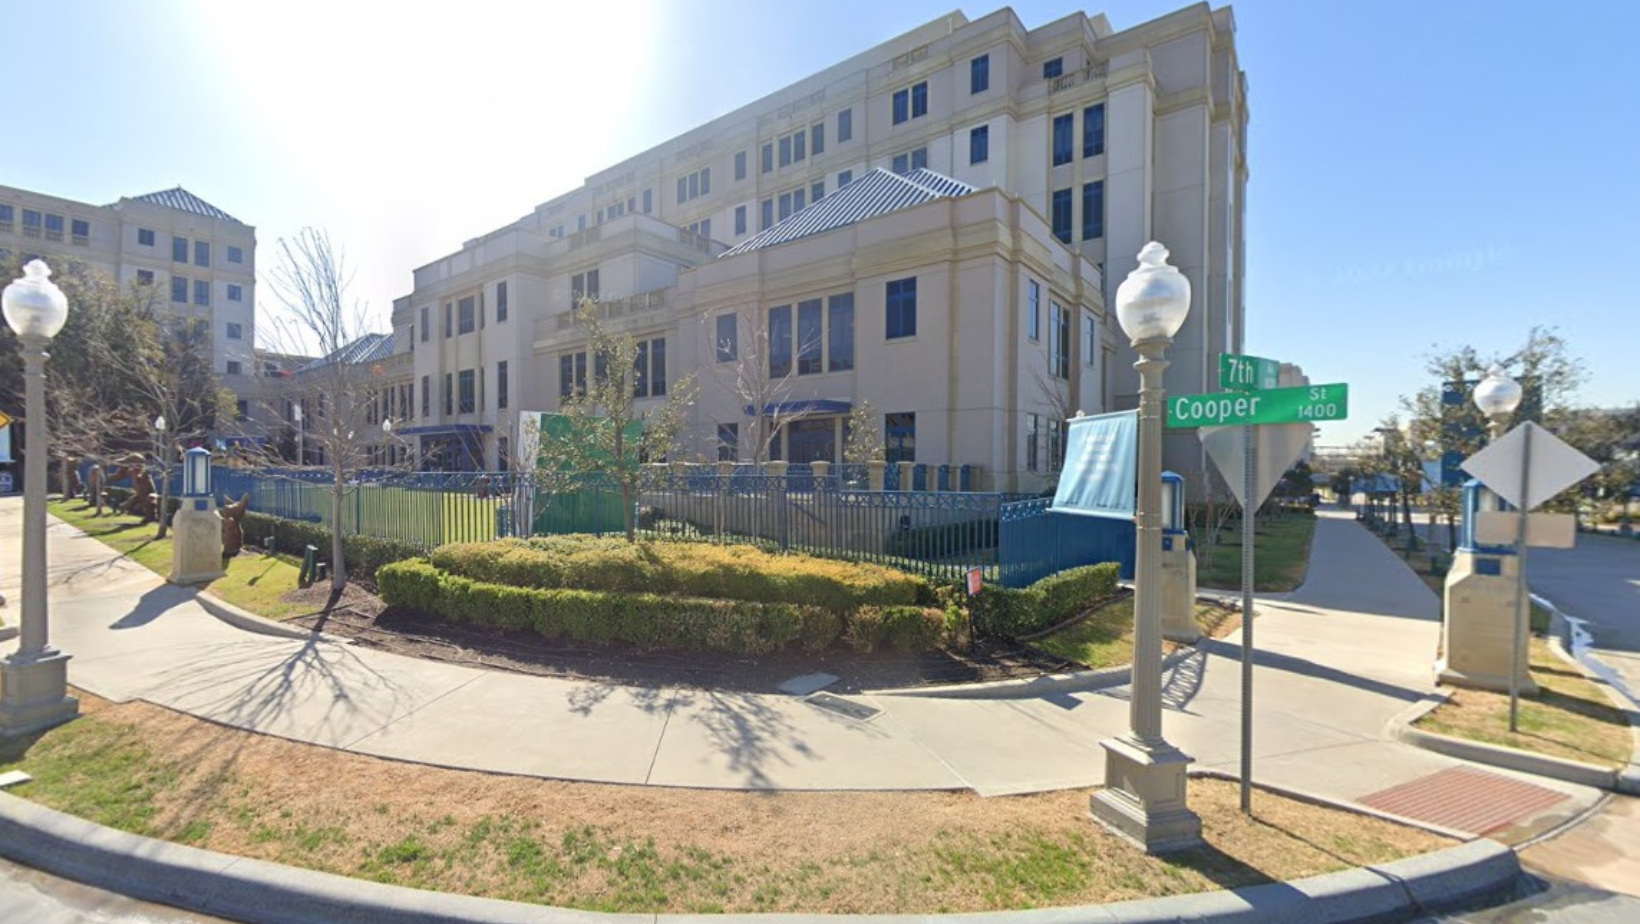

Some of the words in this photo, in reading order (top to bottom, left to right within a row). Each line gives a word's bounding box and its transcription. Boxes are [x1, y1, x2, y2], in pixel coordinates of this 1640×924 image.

[1228, 358, 1254, 384] 7th
[1309, 387, 1327, 401] St
[1175, 397, 1261, 422] Cooper
[1297, 403, 1337, 418] 1400
